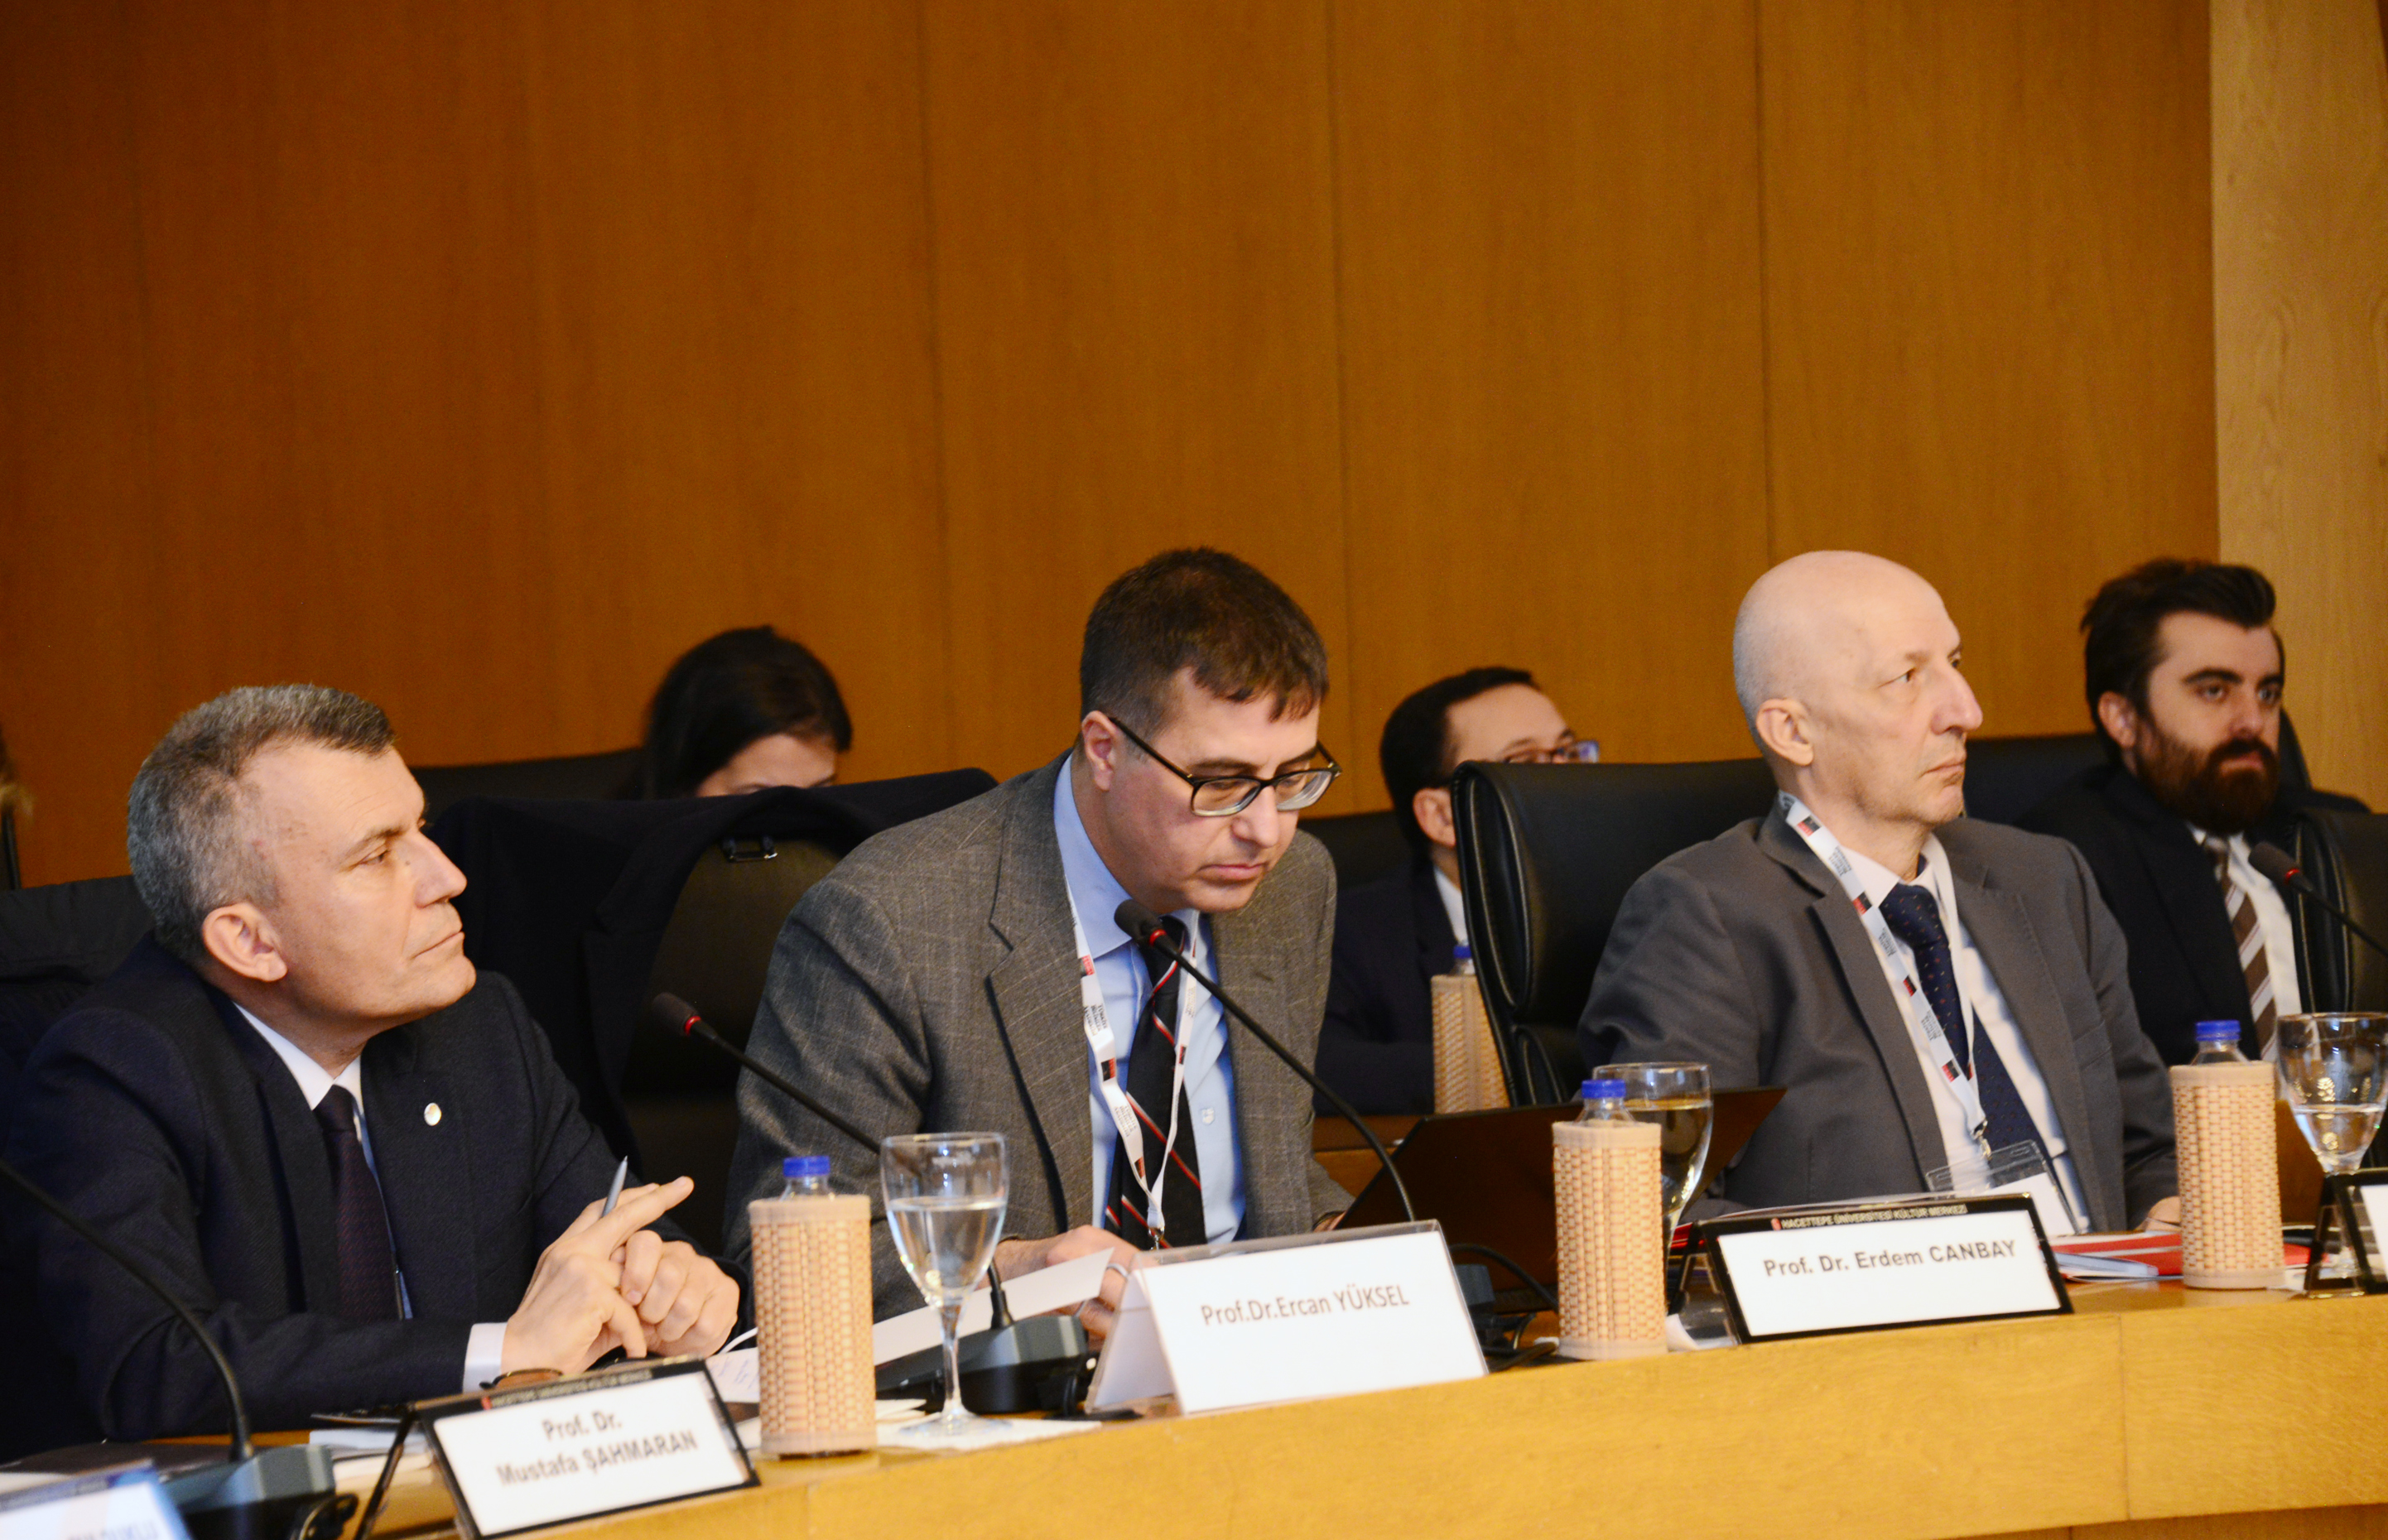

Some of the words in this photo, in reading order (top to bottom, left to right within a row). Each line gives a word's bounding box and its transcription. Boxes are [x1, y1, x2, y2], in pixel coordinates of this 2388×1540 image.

[1763, 1258, 1813, 1278] Prof.
[1818, 1254, 1849, 1273] Dr.
[1853, 1250, 1923, 1269] Erdem
[1928, 1239, 2017, 1263] CANBAY
[1201, 1297, 1332, 1325] Prof.Dr.Ercan
[1333, 1283, 1410, 1310] YÜKSEL
[542, 1415, 590, 1441] Prof.
[592, 1410, 622, 1432] Dr.
[497, 1454, 579, 1485] Mustafa
[582, 1430, 697, 1475] ŞAHMARAN
